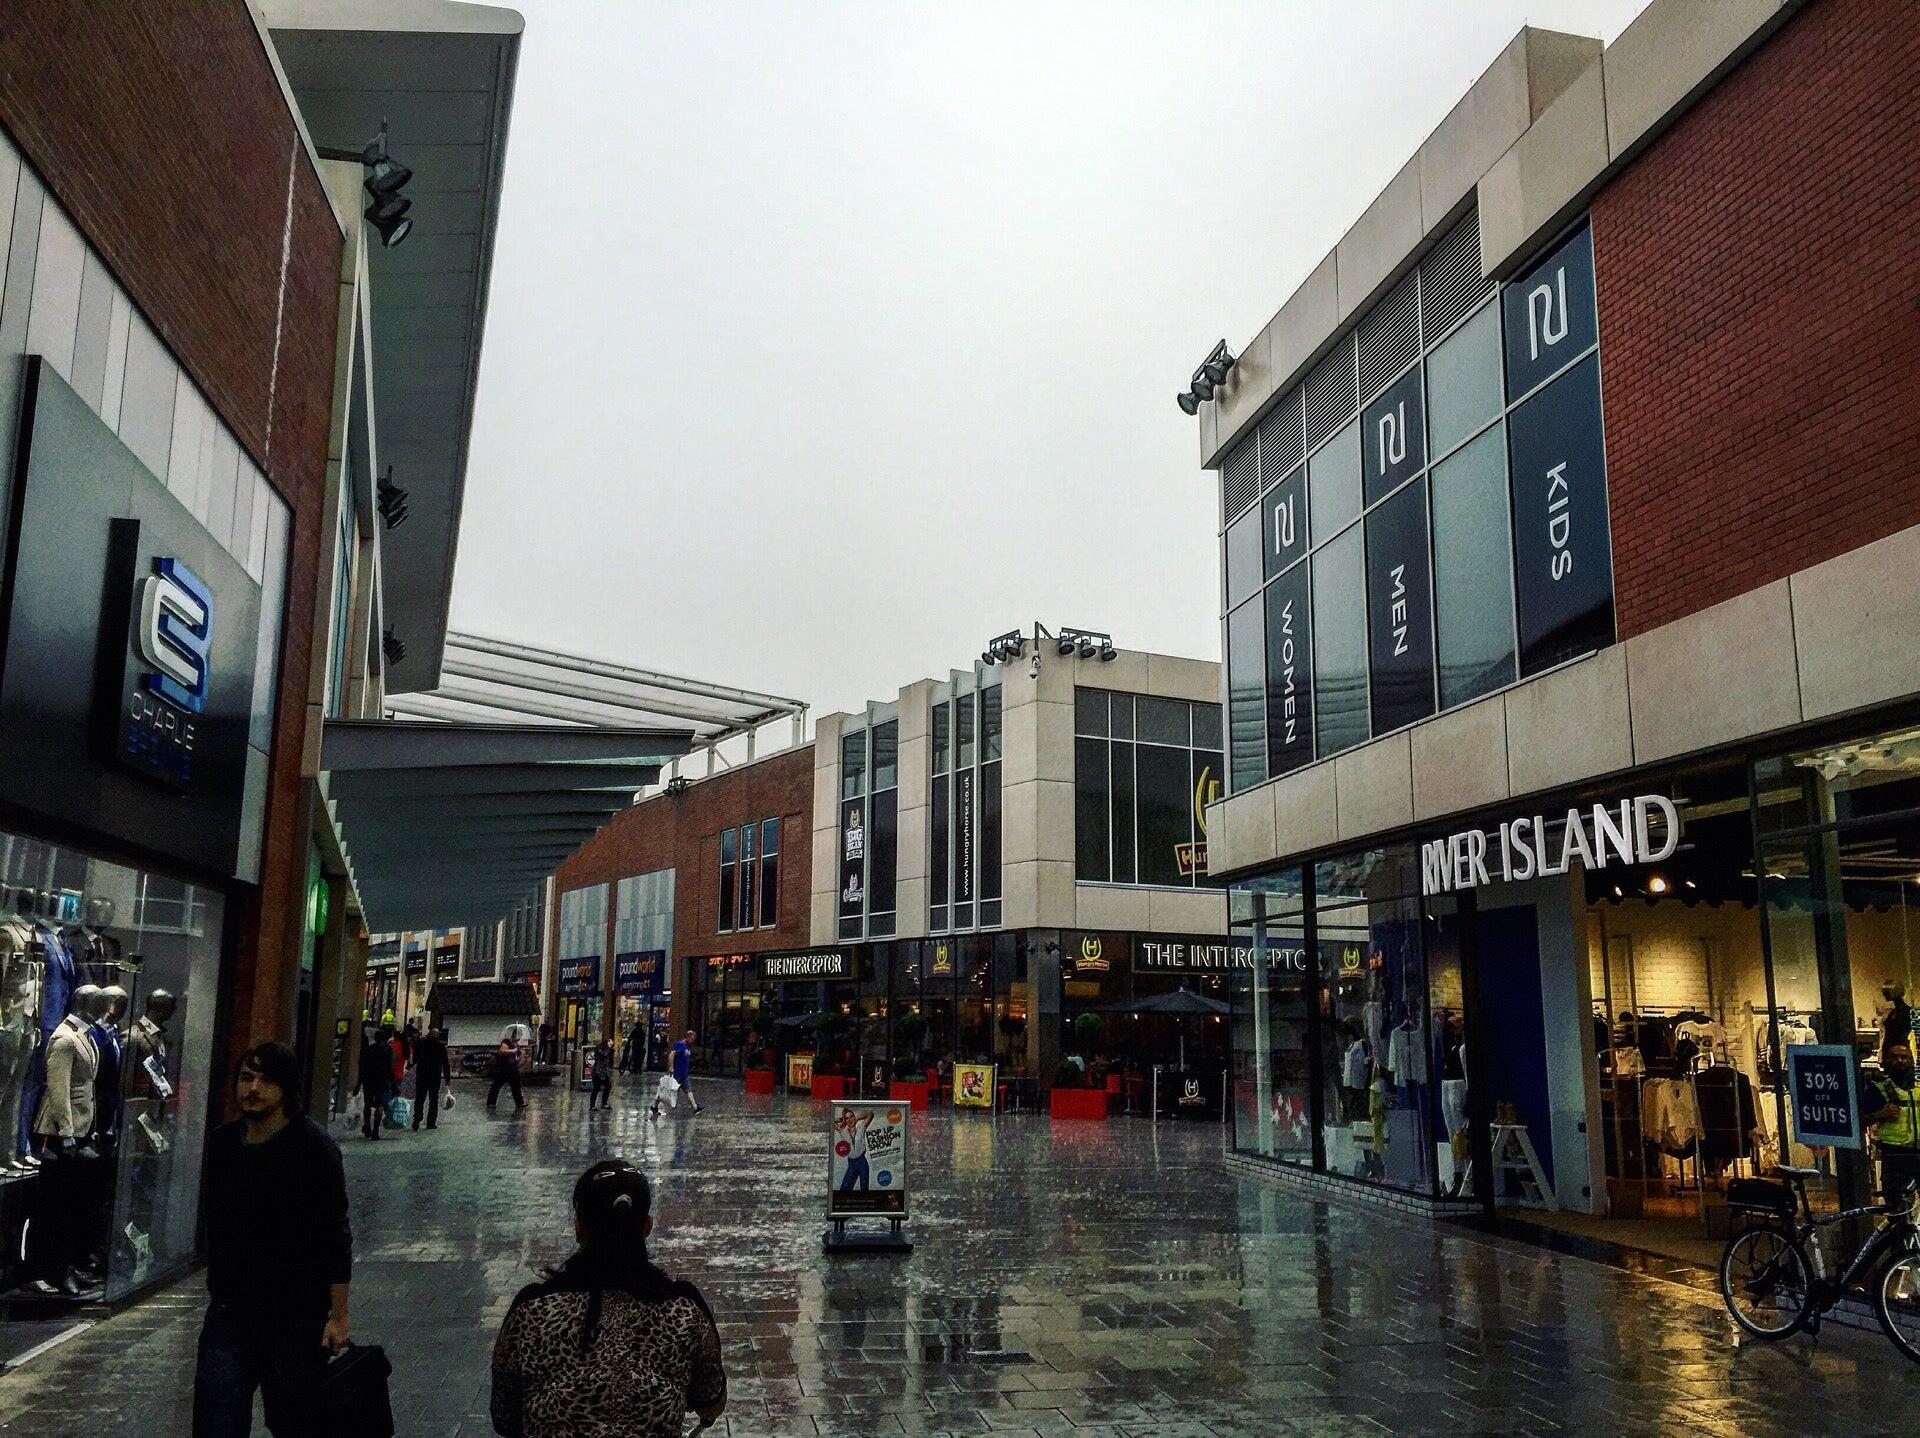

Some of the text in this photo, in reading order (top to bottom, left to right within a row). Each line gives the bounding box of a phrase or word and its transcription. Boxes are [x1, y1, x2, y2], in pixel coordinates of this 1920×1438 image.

[1546, 461, 1572, 581] KIDS
[1390, 564, 1408, 657] MEN
[1282, 600, 1296, 744] WOMEN
[1421, 794, 1679, 896] RIVER ISLAND
[1143, 943, 1185, 967] THE
[766, 958, 782, 976] THE
[1804, 1072, 1840, 1090] 30%
[1802, 1105, 1848, 1124] SUITS
[866, 1126, 894, 1139] POP UP
[867, 1131, 901, 1145] FASHION
[868, 1140, 892, 1151] SHOW
